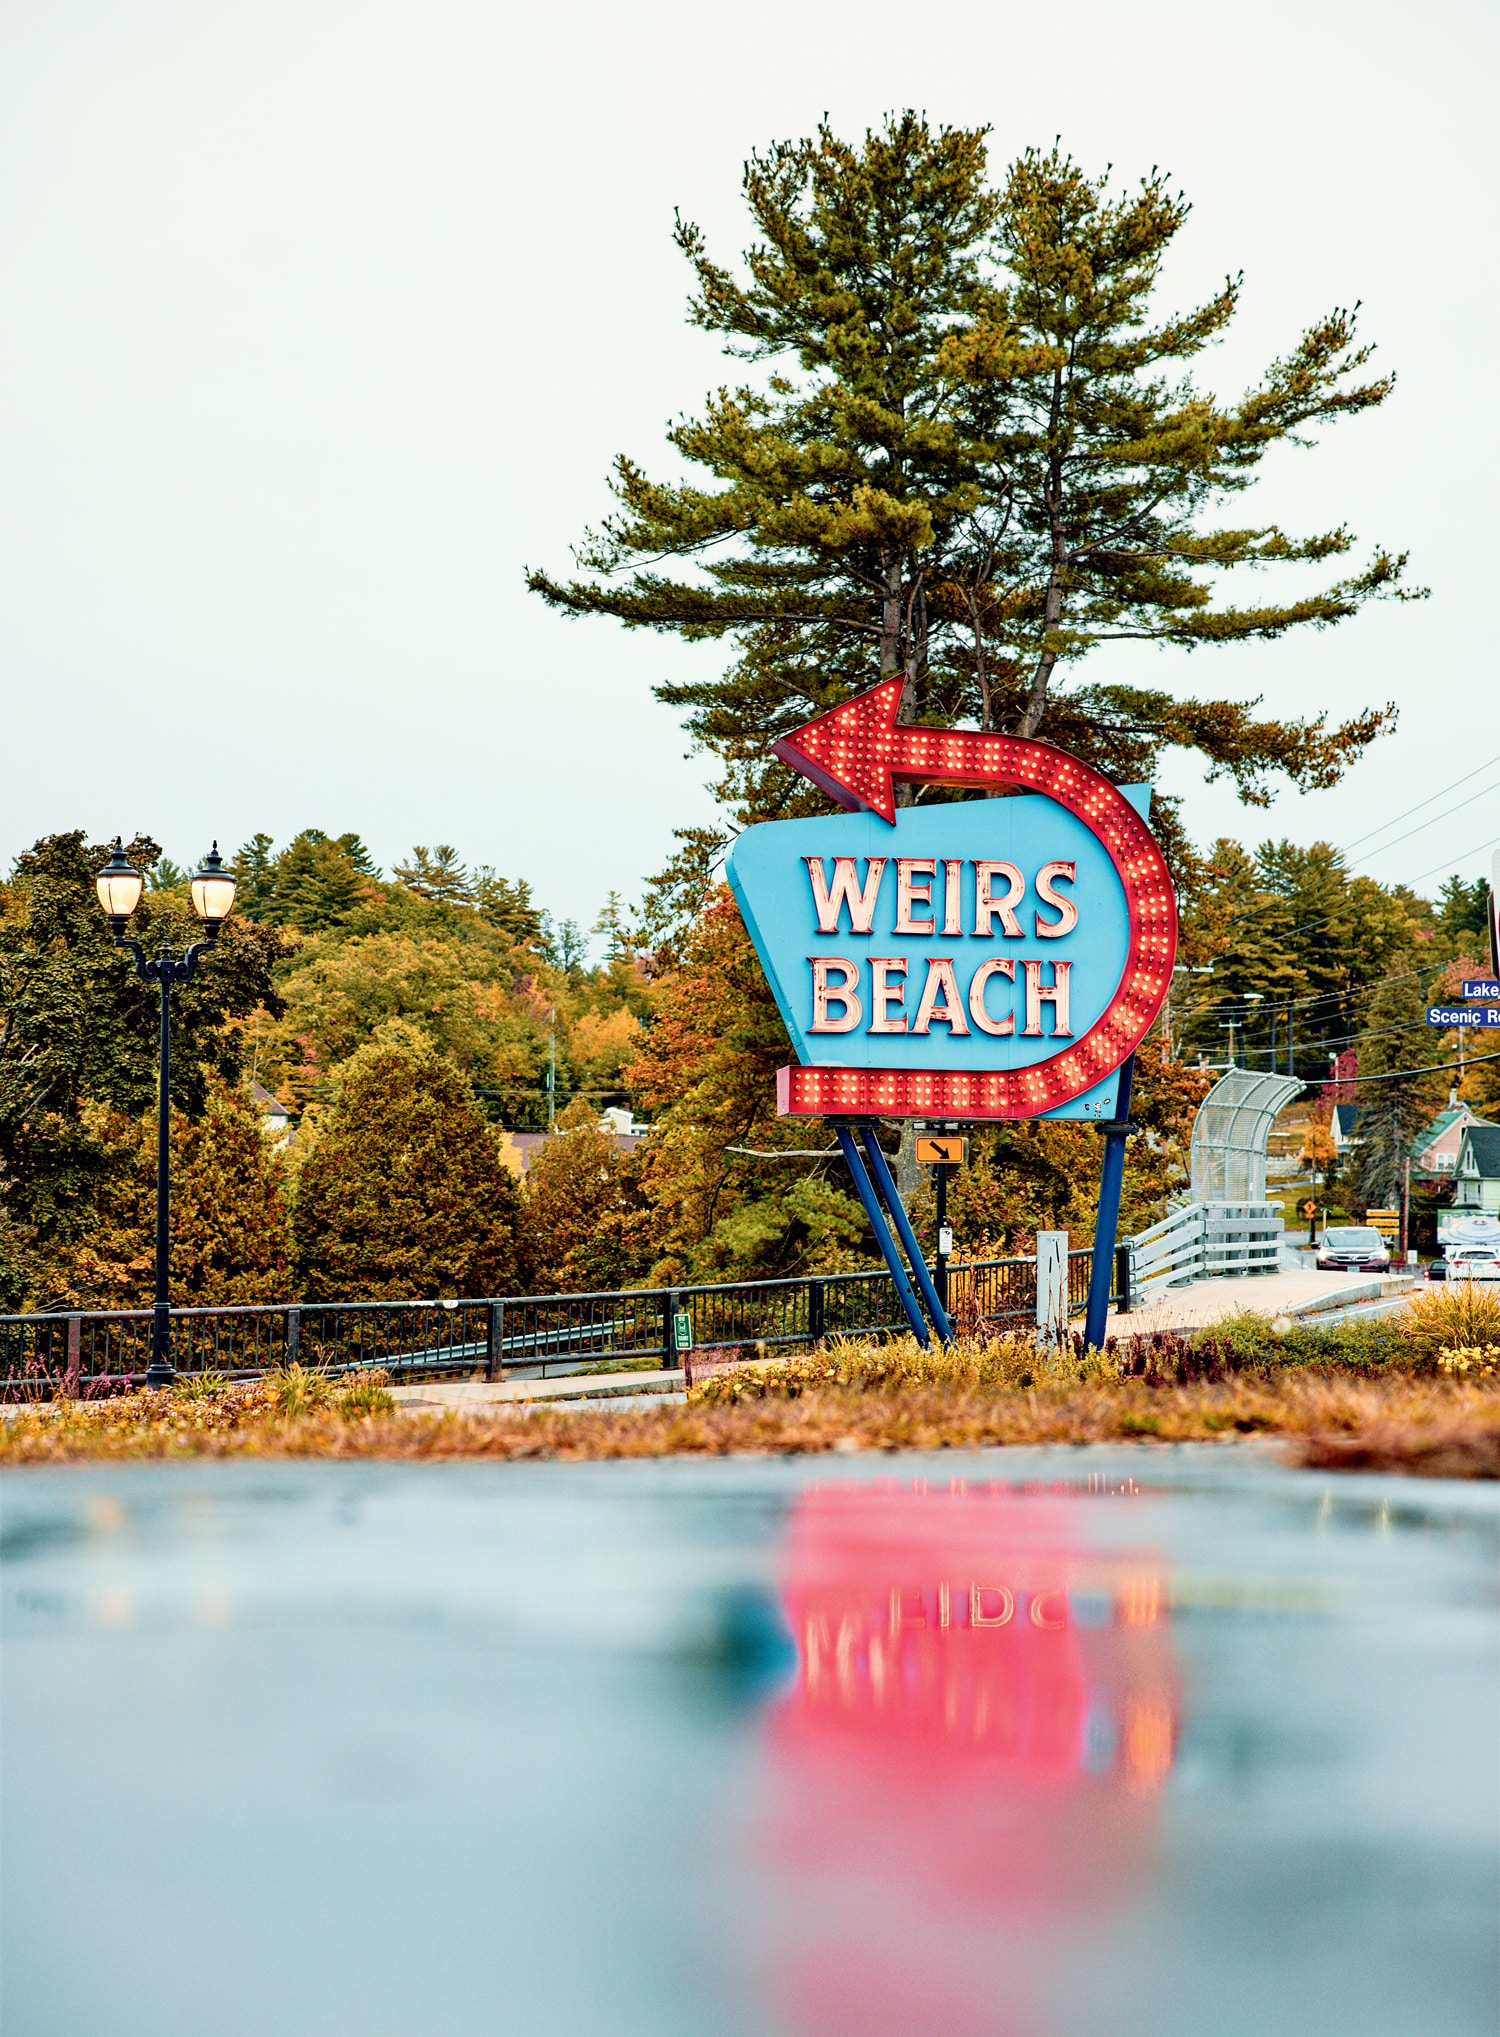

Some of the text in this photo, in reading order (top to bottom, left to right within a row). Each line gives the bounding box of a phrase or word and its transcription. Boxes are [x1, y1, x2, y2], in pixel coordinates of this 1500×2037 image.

[801, 856, 1079, 938] WEIRS
[806, 956, 1075, 1037] BEACH
[1464, 982, 1499, 997] Lake
[1429, 1008, 1500, 1023] Scenic R
